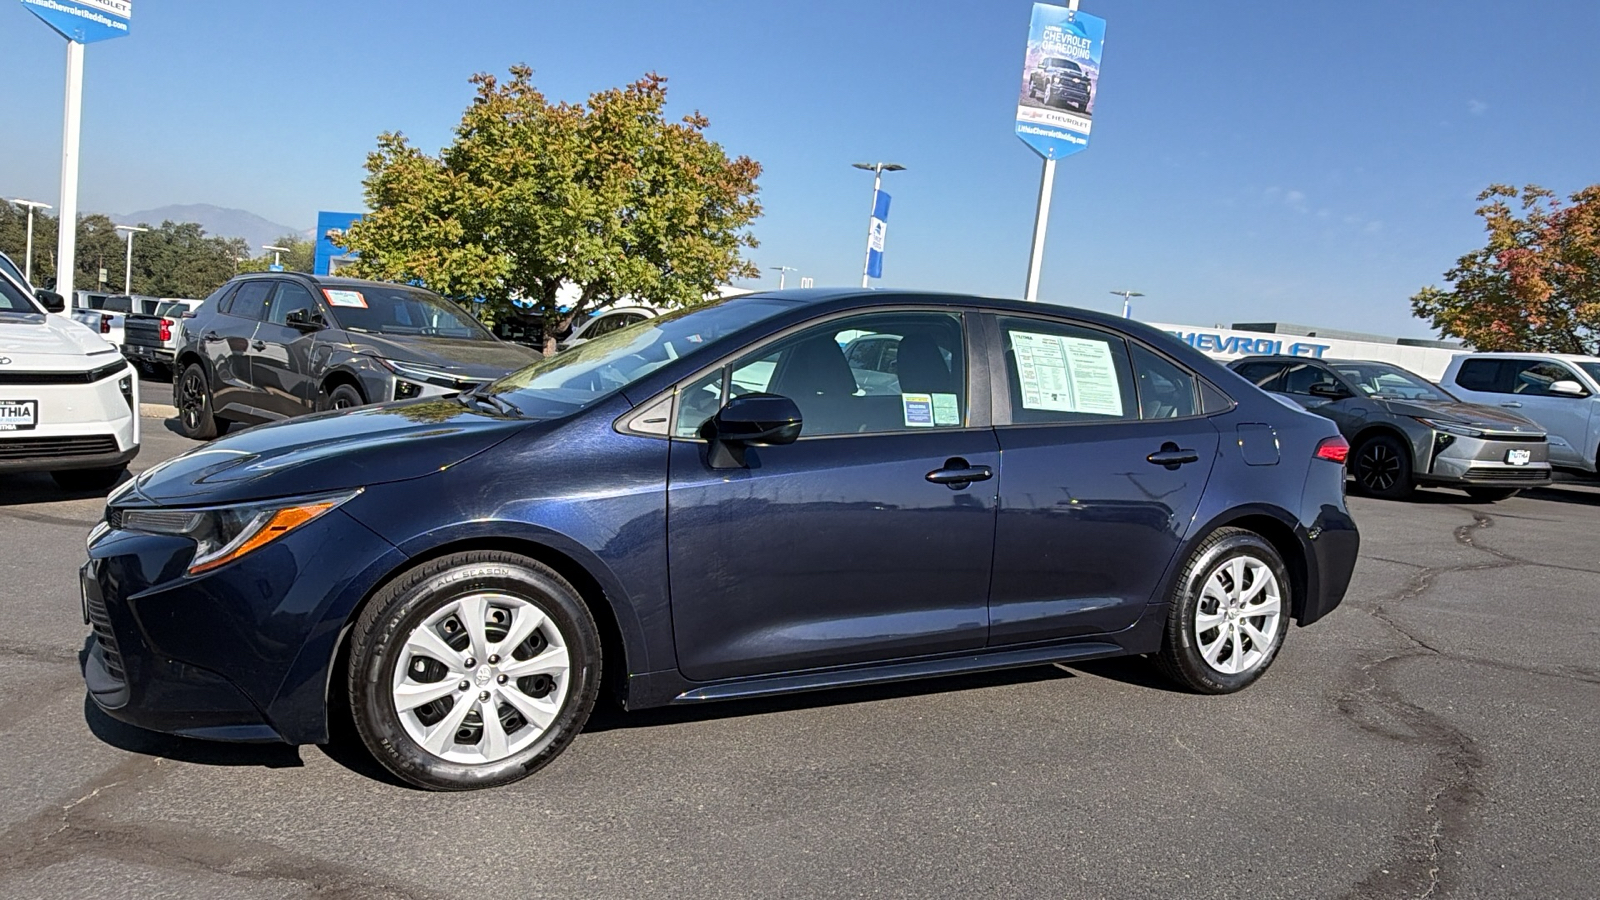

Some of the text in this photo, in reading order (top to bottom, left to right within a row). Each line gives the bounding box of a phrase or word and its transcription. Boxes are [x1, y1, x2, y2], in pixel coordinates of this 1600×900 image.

[1043, 30, 1092, 49] CHEVROLET
[1042, 40, 1090, 60] OF REDDING
[1046, 113, 1088, 128] CHEVROLET
[437, 574, 460, 587] ALL
[462, 568, 509, 578] SEASON
